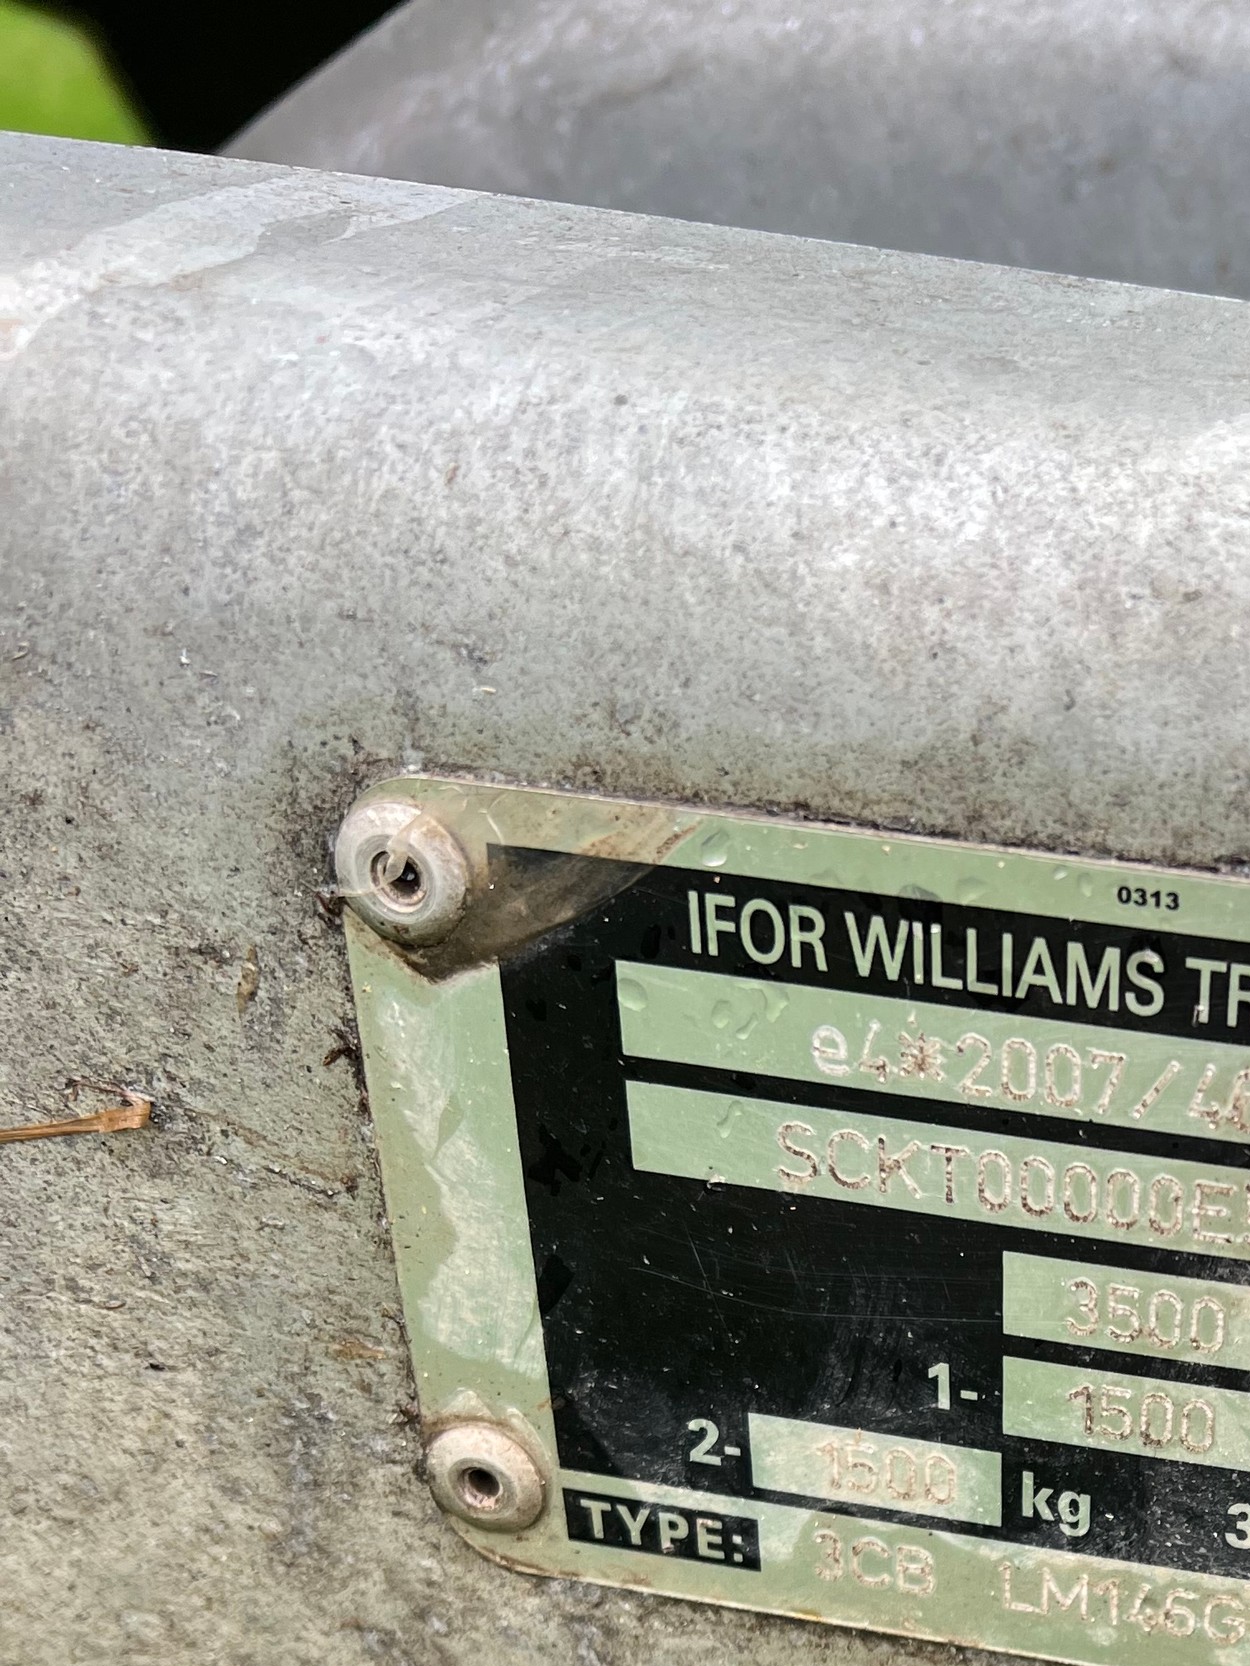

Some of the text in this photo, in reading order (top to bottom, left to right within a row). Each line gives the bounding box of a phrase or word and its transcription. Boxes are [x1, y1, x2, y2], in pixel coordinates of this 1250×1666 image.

[1116, 885, 1181, 912] 0313
[687, 889, 829, 973] IFOR
[844, 911, 1166, 1018] WILLIAMS
[1064, 1276, 1226, 1354] 3500
[1066, 1381, 1217, 1454] 1500
[814, 1438, 959, 1505] 1500
[1021, 1470, 1092, 1538] kg
[579, 1498, 744, 1564] TYPE:
